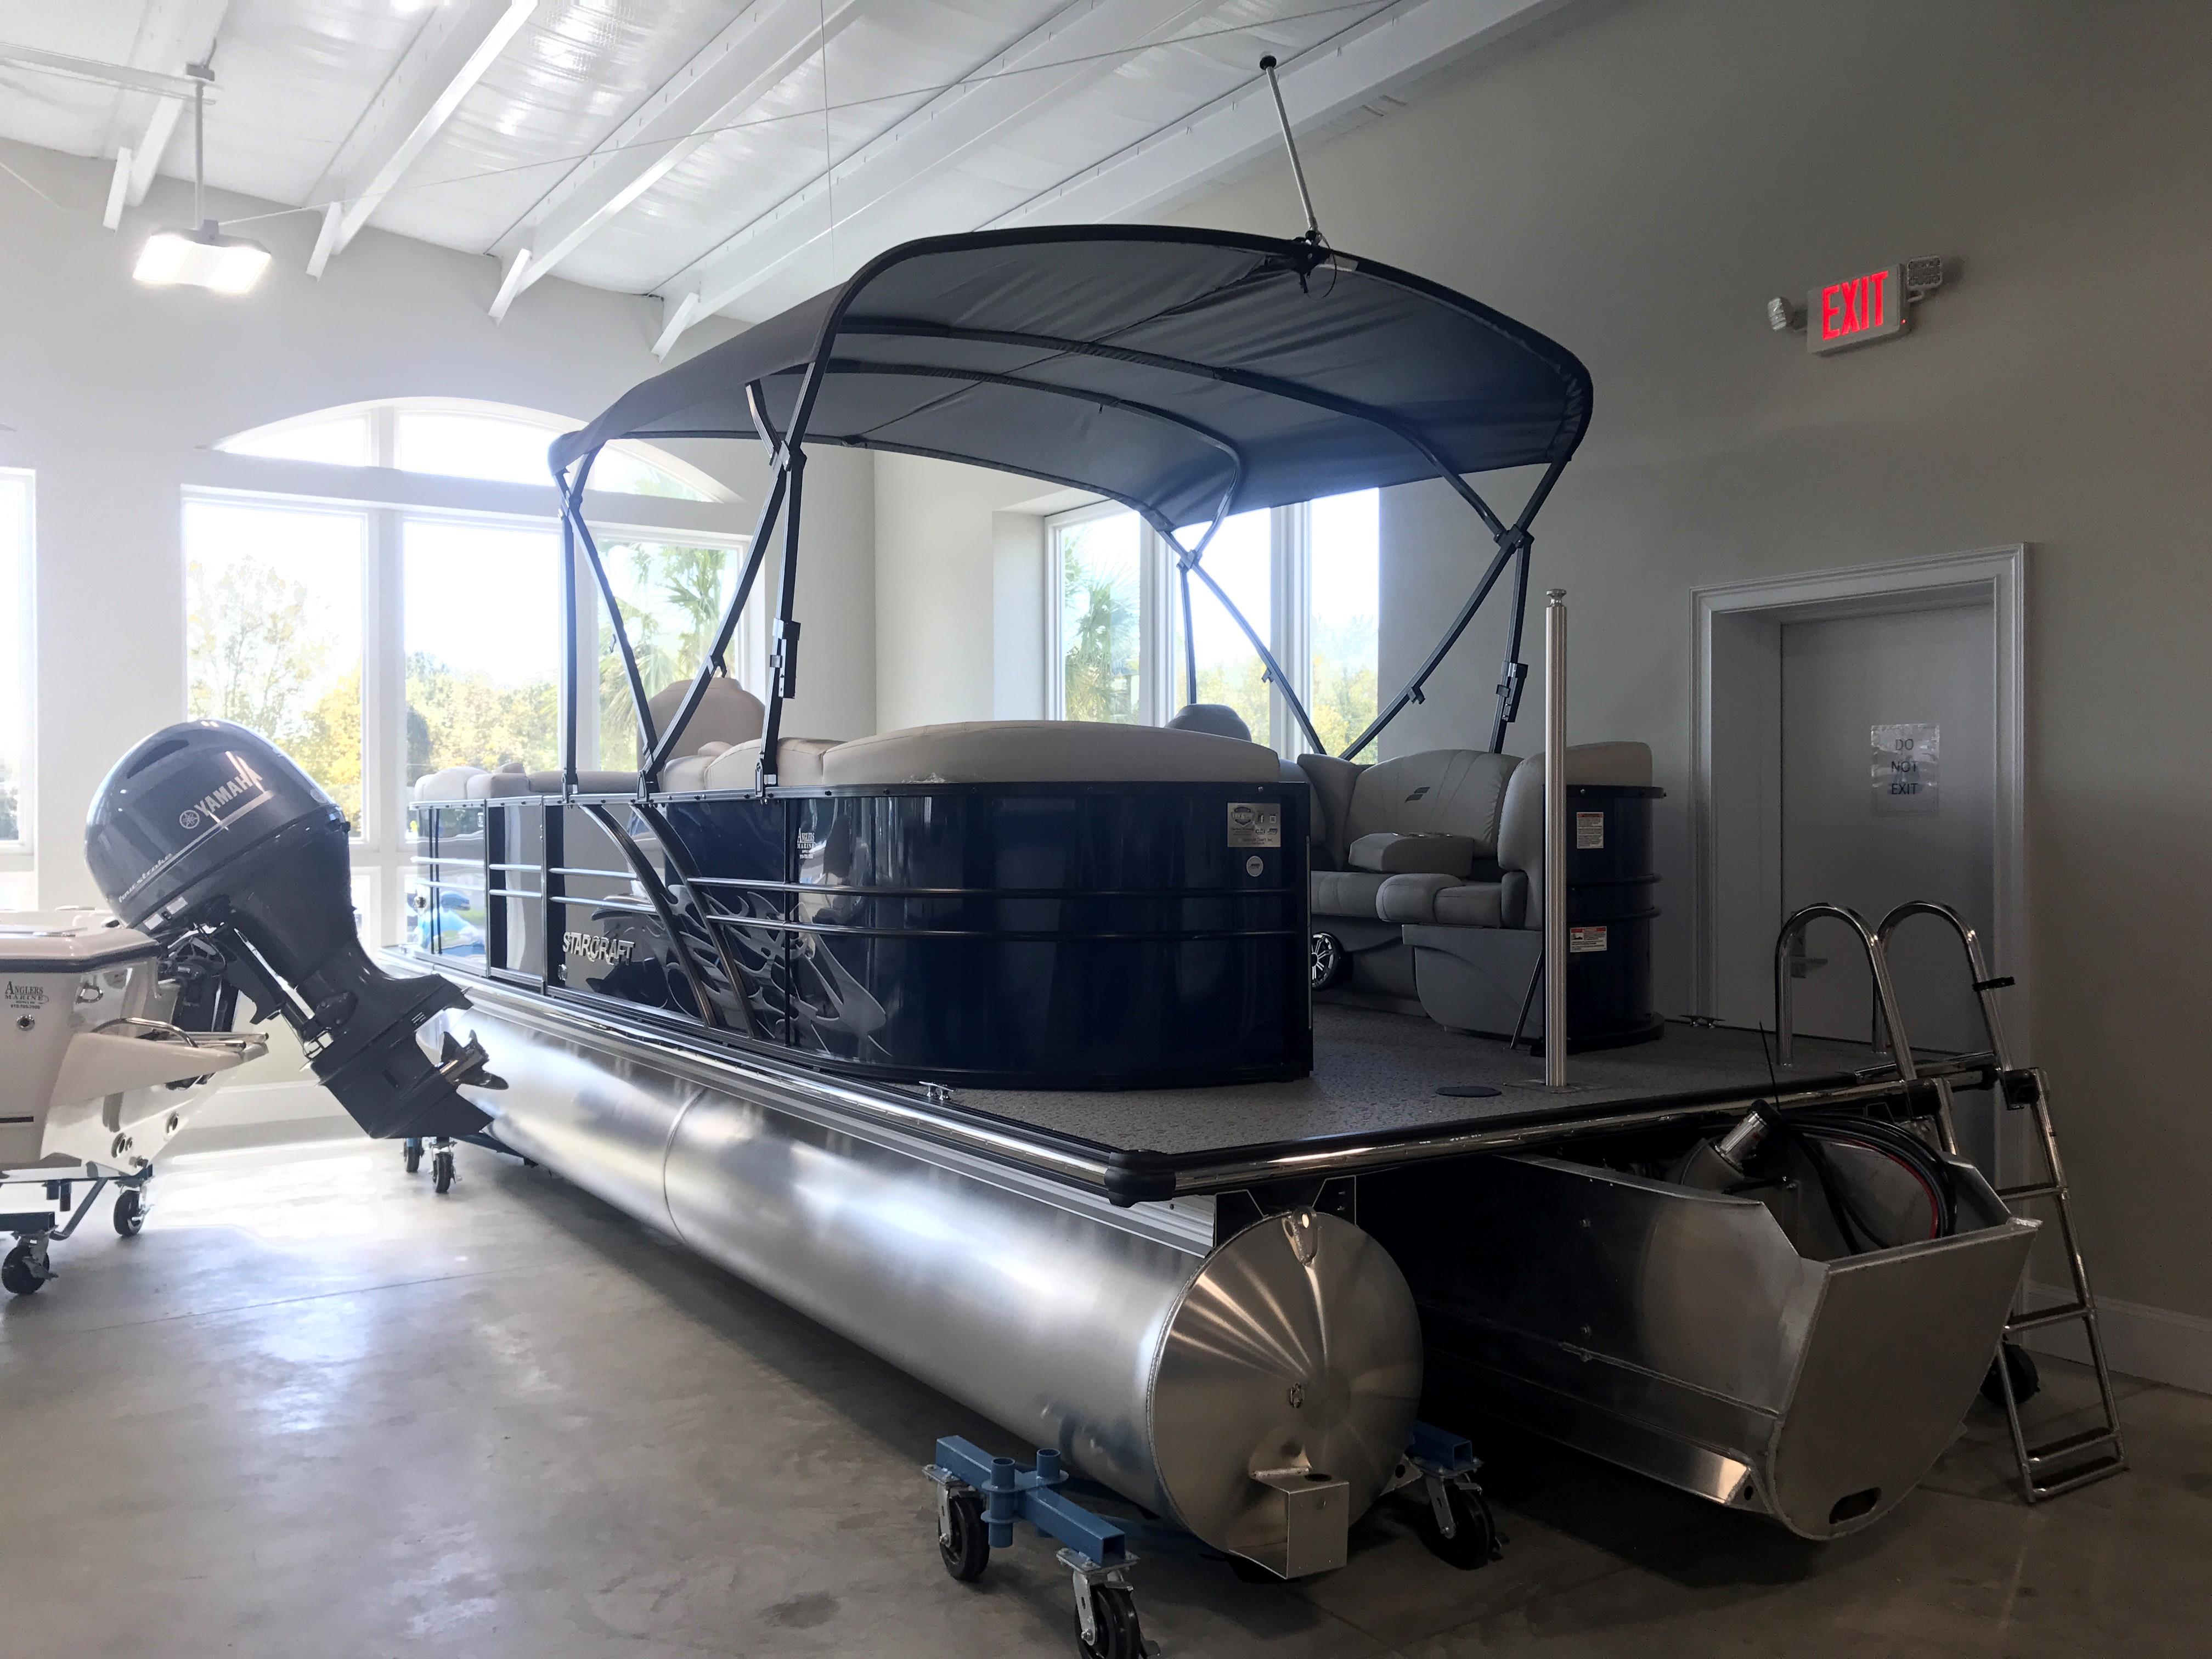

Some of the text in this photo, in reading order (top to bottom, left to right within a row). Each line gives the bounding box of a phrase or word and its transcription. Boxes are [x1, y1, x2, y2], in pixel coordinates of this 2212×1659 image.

[1822, 270, 1888, 341] EXIT
[1895, 739, 1914, 751] DO
[1891, 761, 1918, 772] NOT
[194, 769, 263, 817] YAMAHA
[1891, 783, 1918, 794] EXIT
[562, 932, 635, 966] STARCRAFT
[5, 981, 43, 995] ANGLERS
